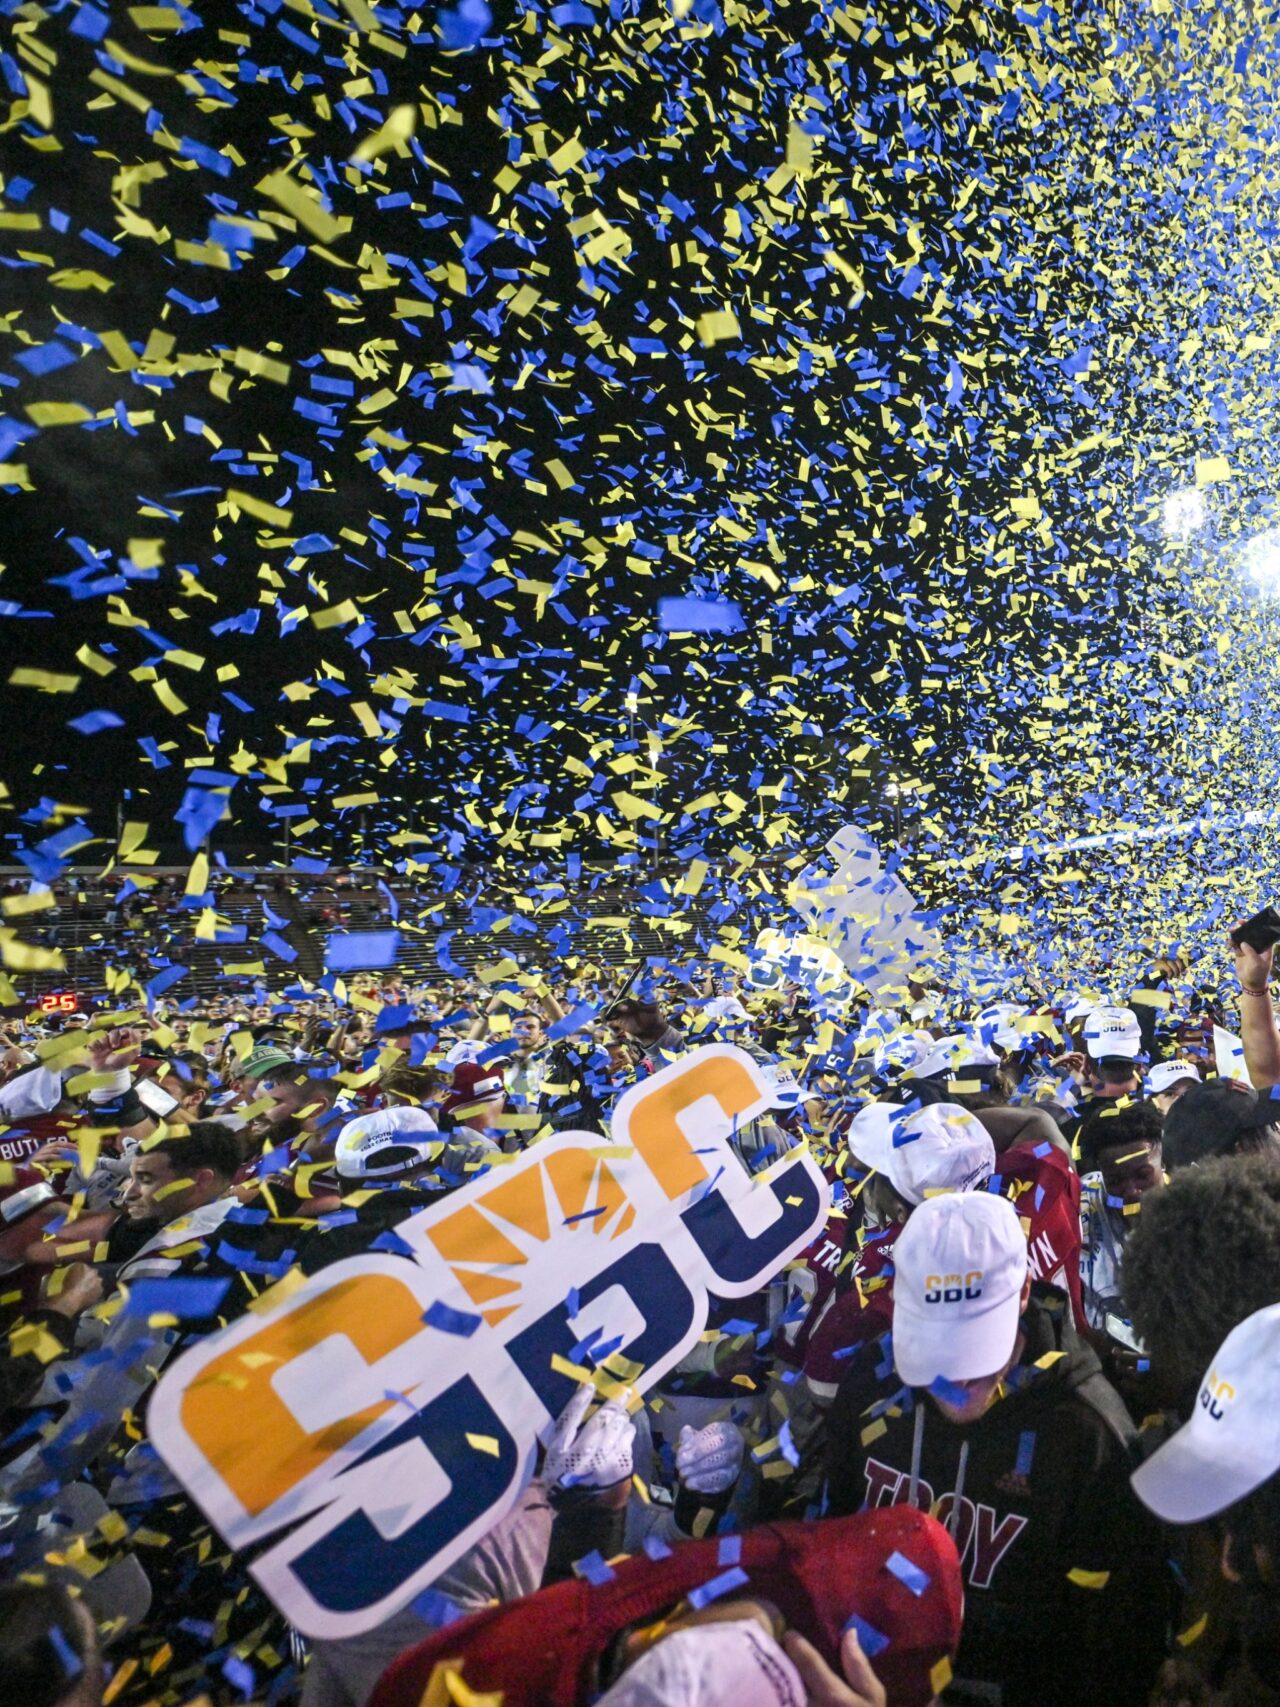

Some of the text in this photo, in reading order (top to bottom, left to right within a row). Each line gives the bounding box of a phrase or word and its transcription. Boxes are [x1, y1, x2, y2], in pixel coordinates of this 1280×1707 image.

[42, 995, 76, 1012] 25
[1027, 1229, 1059, 1281] WN
[924, 1270, 984, 1304] SBC
[180, 1055, 820, 1612] SBC
